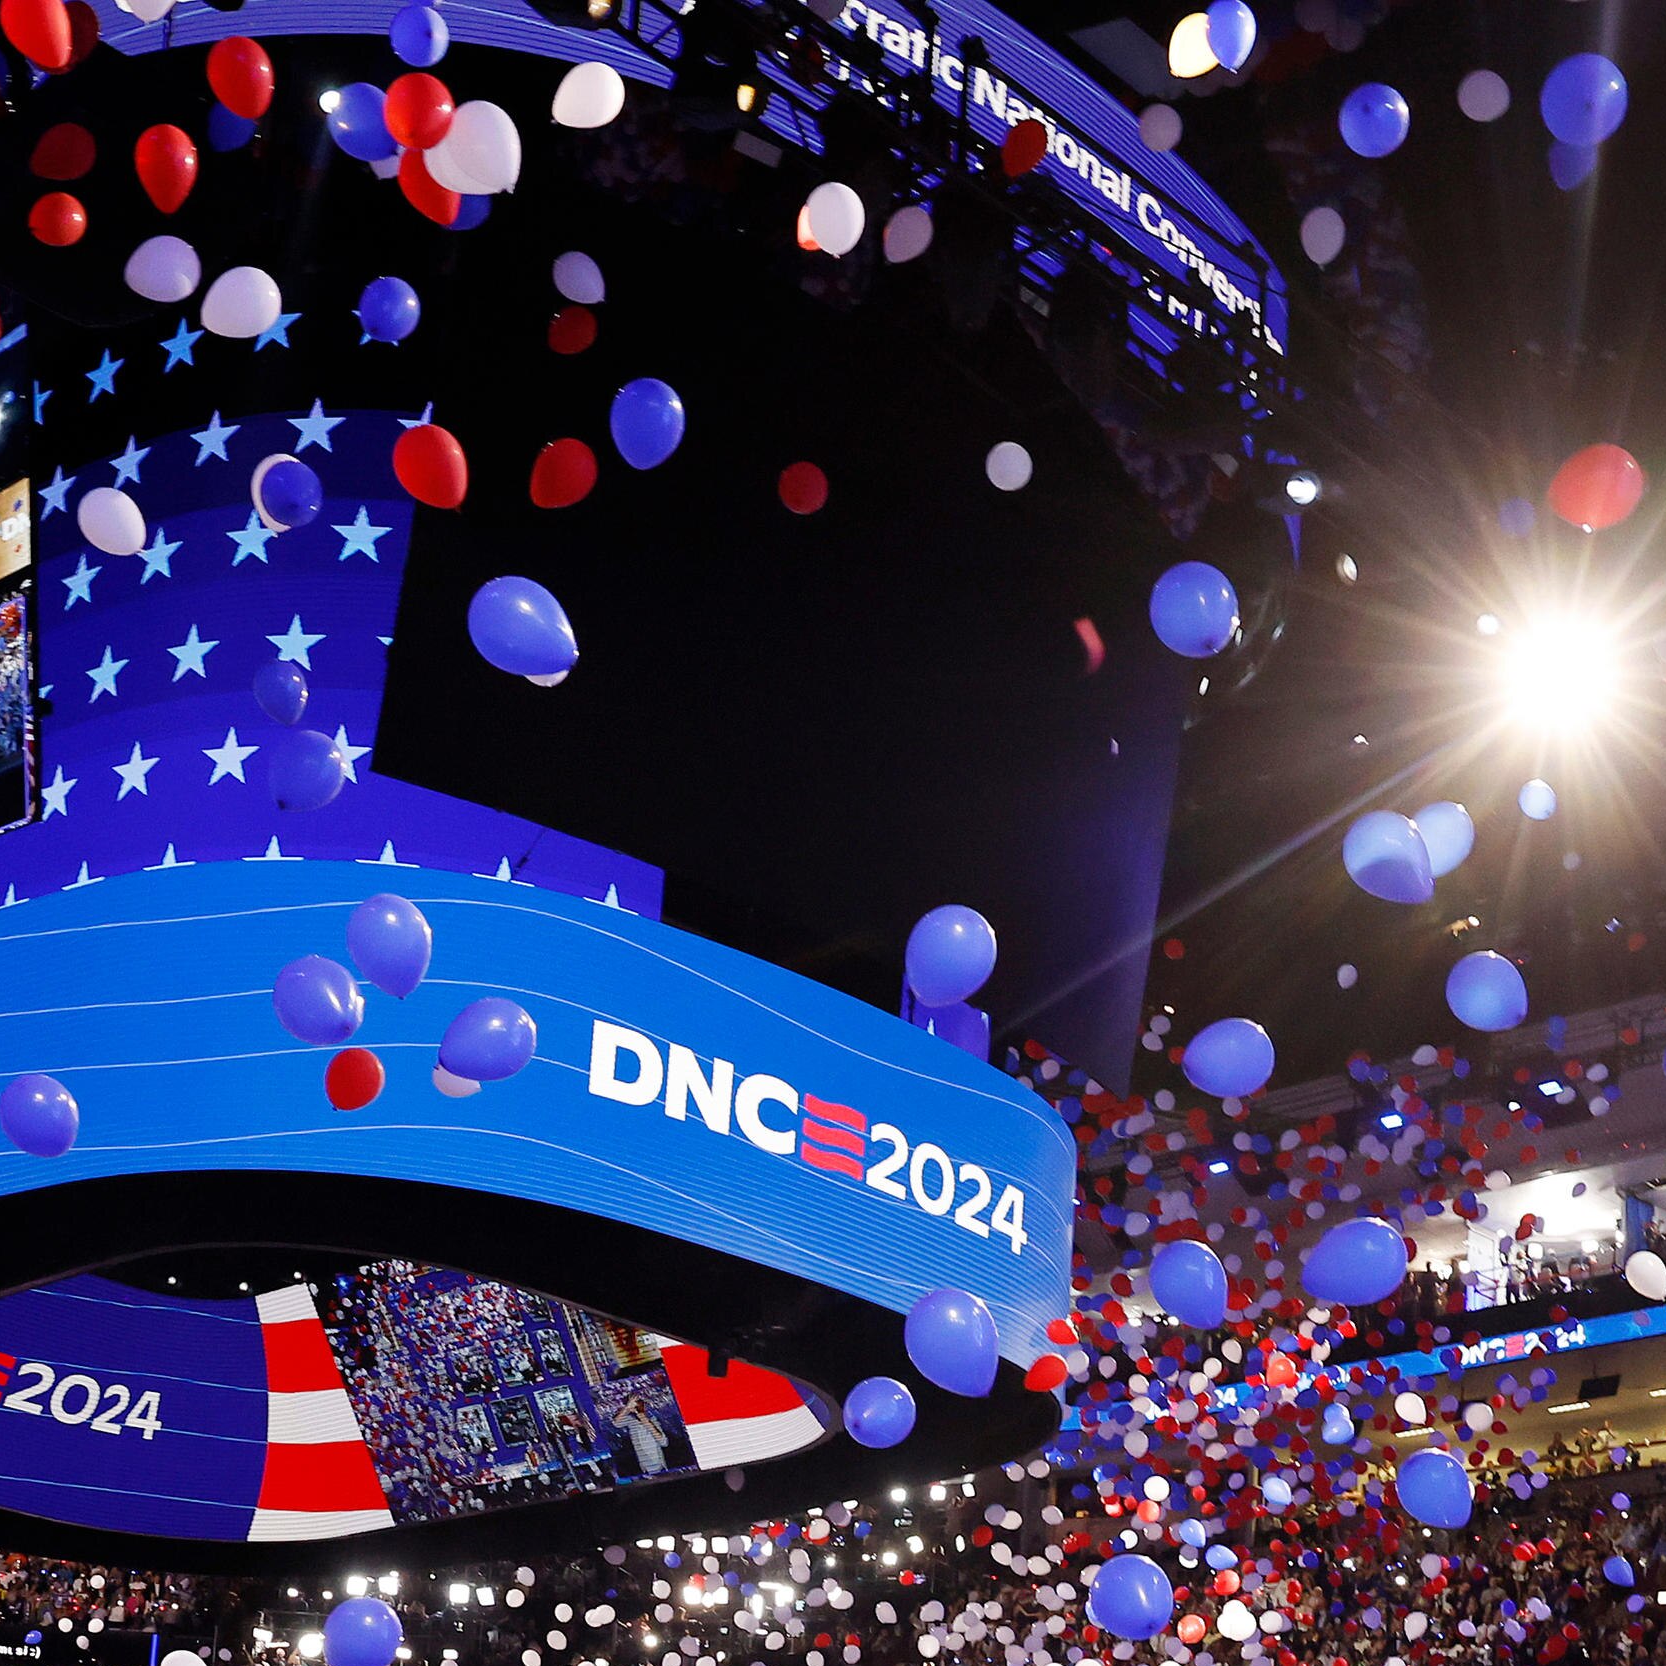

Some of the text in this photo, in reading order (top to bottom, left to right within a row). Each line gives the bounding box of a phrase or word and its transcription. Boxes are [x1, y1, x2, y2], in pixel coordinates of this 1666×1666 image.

[588, 1019, 1028, 1256] DNC 2024
[1524, 1323, 1586, 1355] 224
[3, 1362, 162, 1440] 2024
